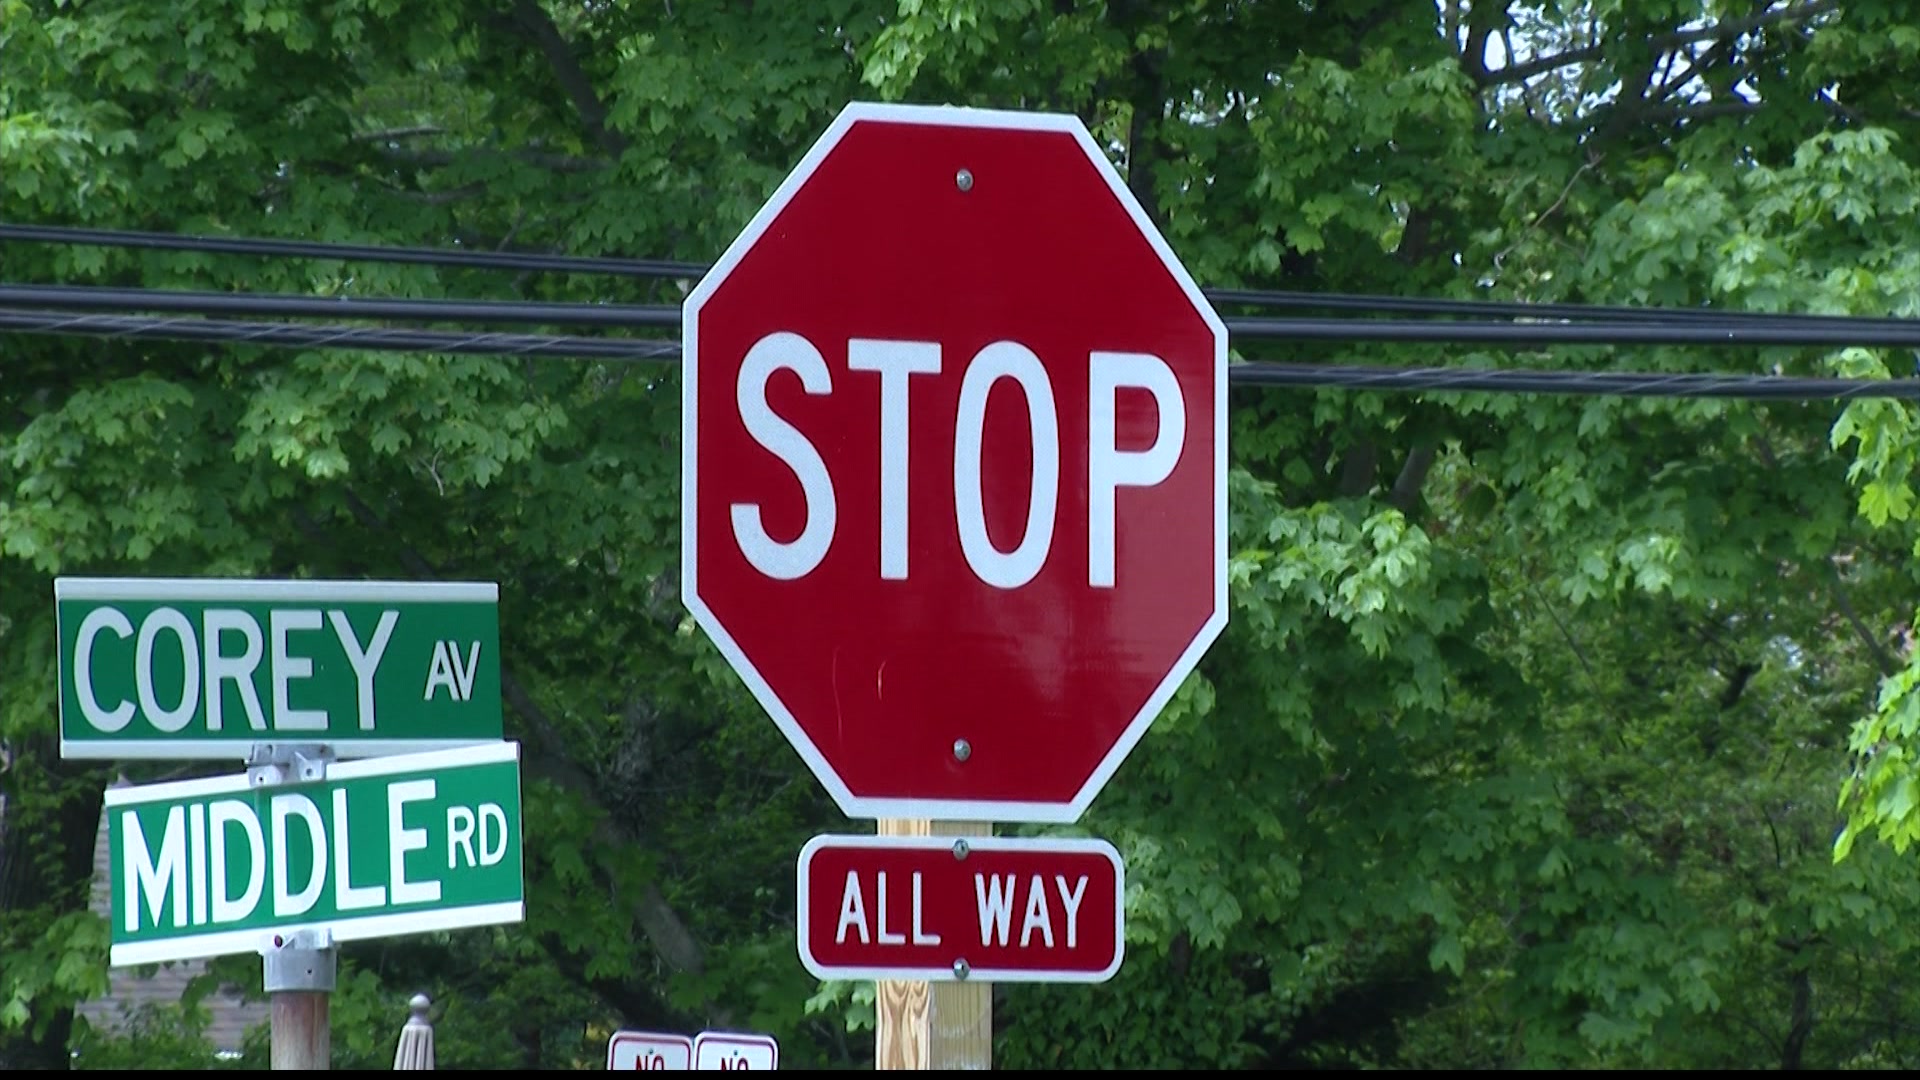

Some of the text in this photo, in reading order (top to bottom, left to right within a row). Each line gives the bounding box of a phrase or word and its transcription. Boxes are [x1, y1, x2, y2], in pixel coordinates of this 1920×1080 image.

[731, 331, 1187, 589] STOP
[73, 606, 480, 733] COREY AV
[123, 779, 508, 931] MIDDLE RD
[835, 870, 1089, 949] ALL WAY
